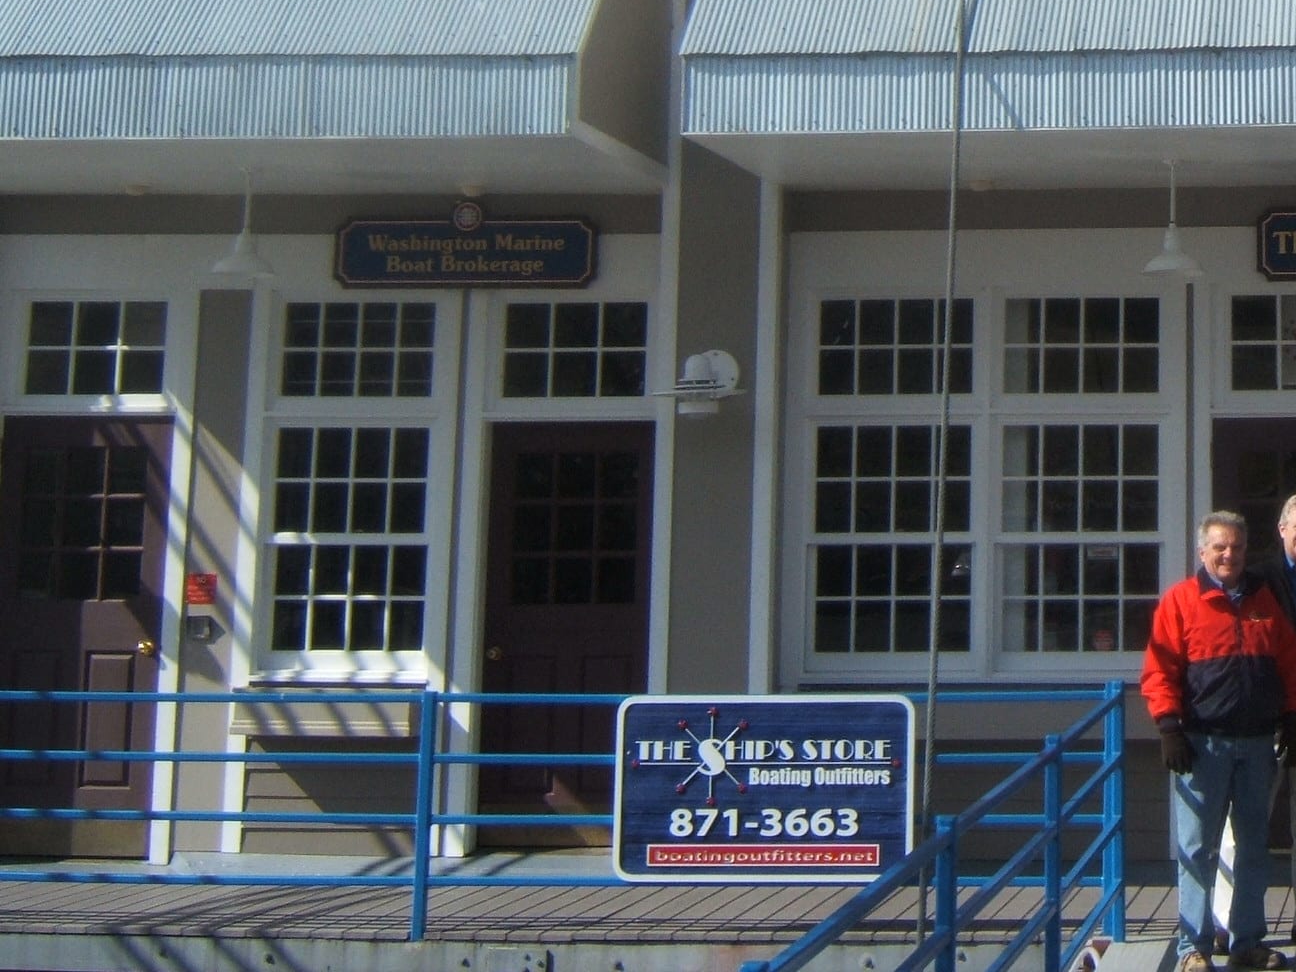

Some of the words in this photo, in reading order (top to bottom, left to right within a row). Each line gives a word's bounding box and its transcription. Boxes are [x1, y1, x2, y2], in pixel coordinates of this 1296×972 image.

[368, 234, 488, 255] Washington
[495, 234, 566, 251] Marine
[386, 255, 434, 273] Boat
[441, 255, 544, 276] Brokerage
[635, 740, 692, 761] THE
[698, 738, 794, 776] SHIP'S
[803, 739, 892, 761] STORE
[749, 767, 811, 787] Boating
[814, 766, 891, 786] Outfitters
[669, 808, 859, 837] 871-3663
[656, 848, 873, 865] boatingoutfitters.net
